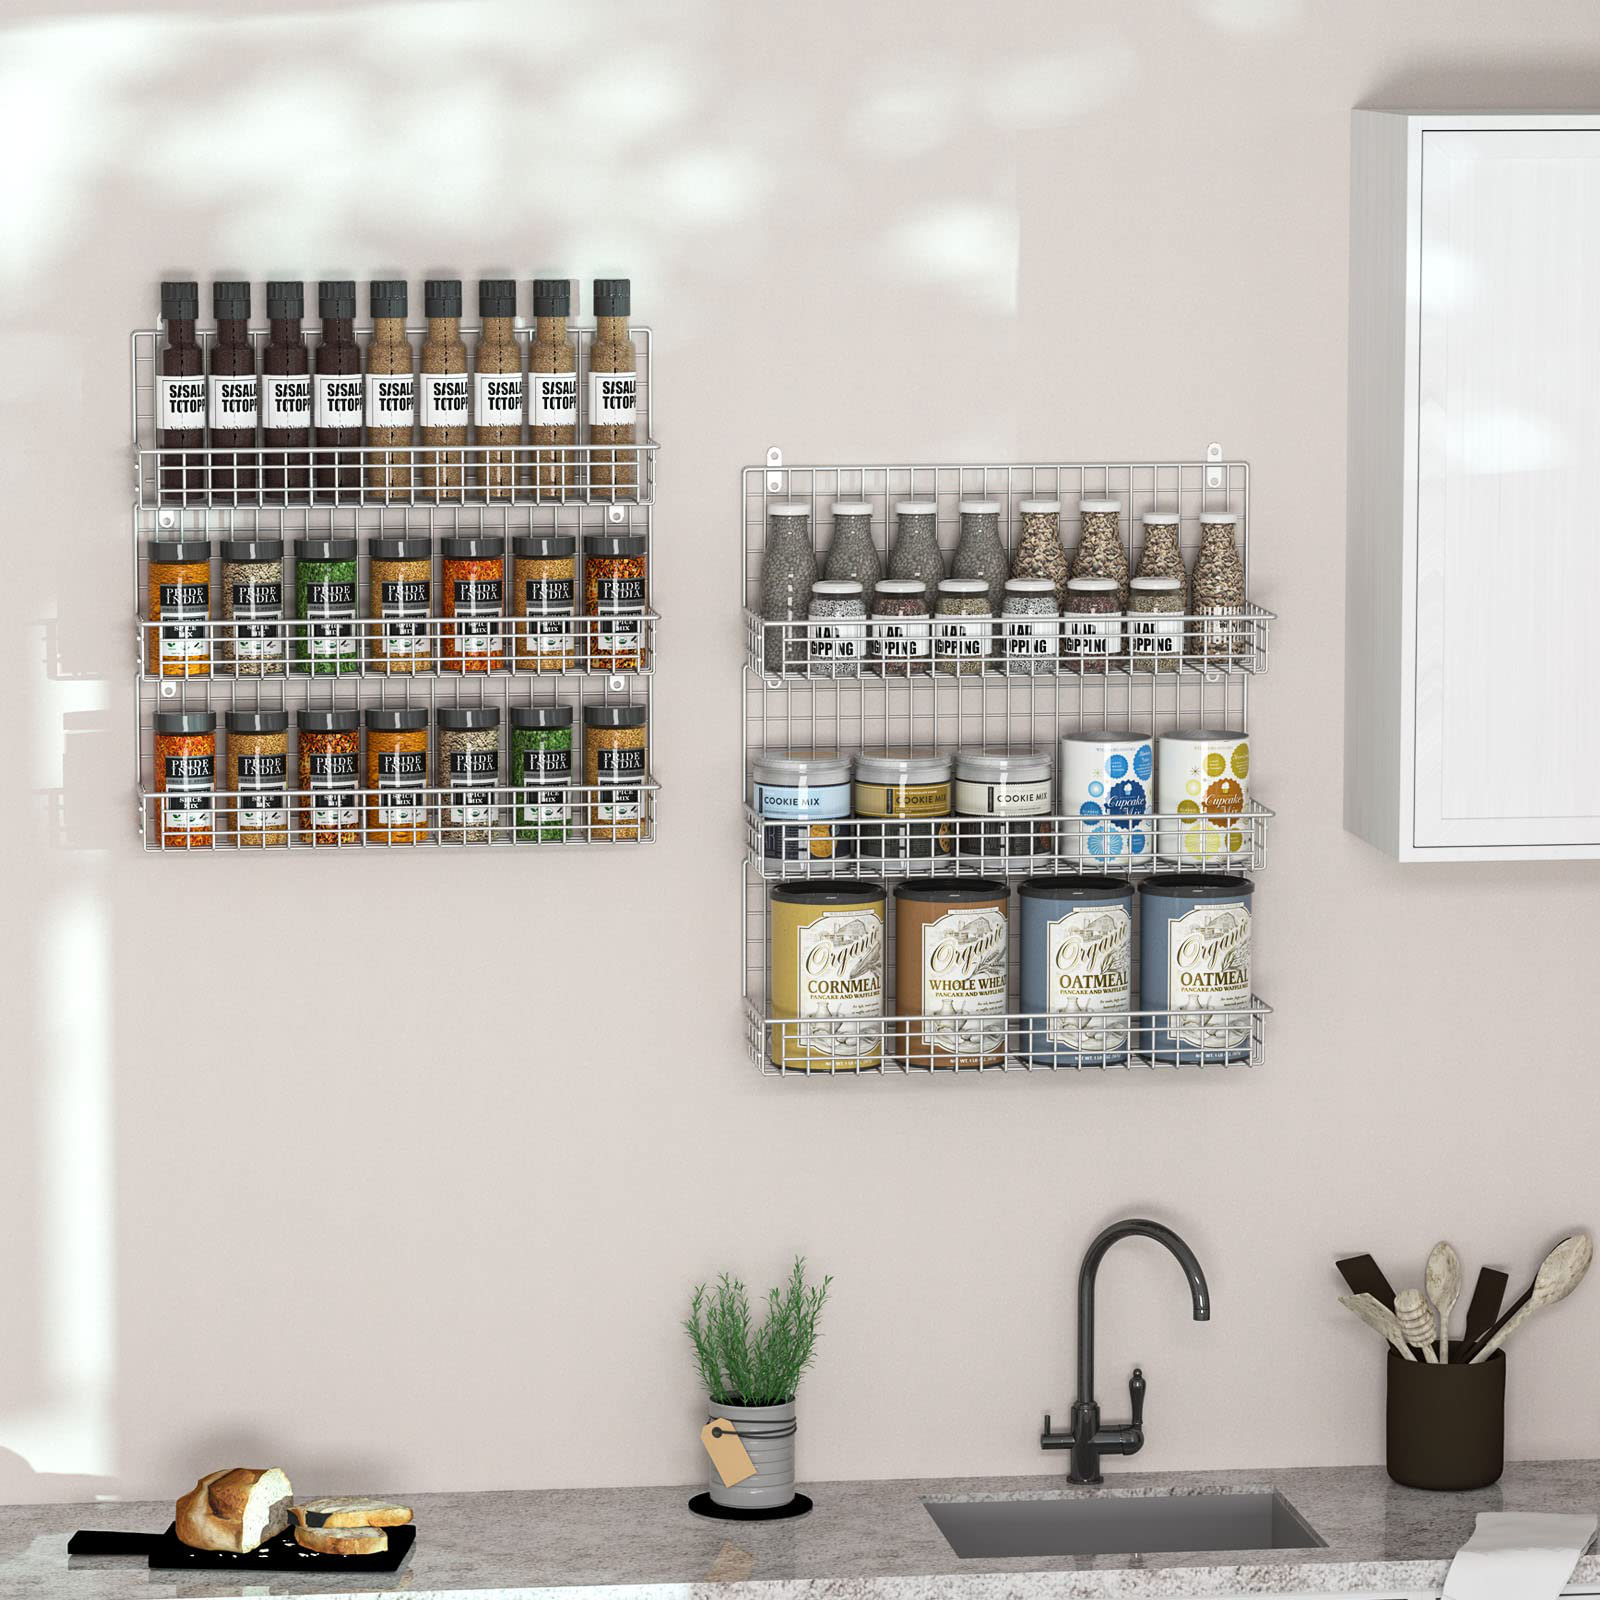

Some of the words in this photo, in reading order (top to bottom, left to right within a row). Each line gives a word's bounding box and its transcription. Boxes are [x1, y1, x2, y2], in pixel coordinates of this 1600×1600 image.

[389, 585, 425, 593] PRIDE
[461, 584, 497, 592] PRIDE
[533, 583, 568, 591] PRIDE
[604, 582, 640, 590] PRIDE
[166, 588, 204, 597] PRIDE
[240, 586, 276, 596] PRIDE
[313, 586, 350, 596] PRIDE
[385, 756, 421, 764] PRIDE
[457, 755, 493, 763] PRIDE
[530, 753, 566, 761] PRIDE
[604, 752, 640, 760] PRIDE
[172, 759, 208, 768] PRIDE
[245, 758, 281, 767] PRIDE
[317, 757, 353, 766] PRIDE
[764, 796, 798, 806] COOKIE
[801, 798, 820, 806] MIX
[896, 796, 932, 804] COOKIE
[997, 794, 1034, 802] COOKIE
[1036, 792, 1047, 800] MIX
[1204, 793, 1241, 807] Cupcake
[1107, 795, 1145, 809] Cupcake
[1060, 971, 1128, 988] OATMEAL
[1181, 969, 1248, 986] OATMEAL
[808, 976, 880, 993] CORNMEAL
[929, 980, 976, 990] WHOLE
